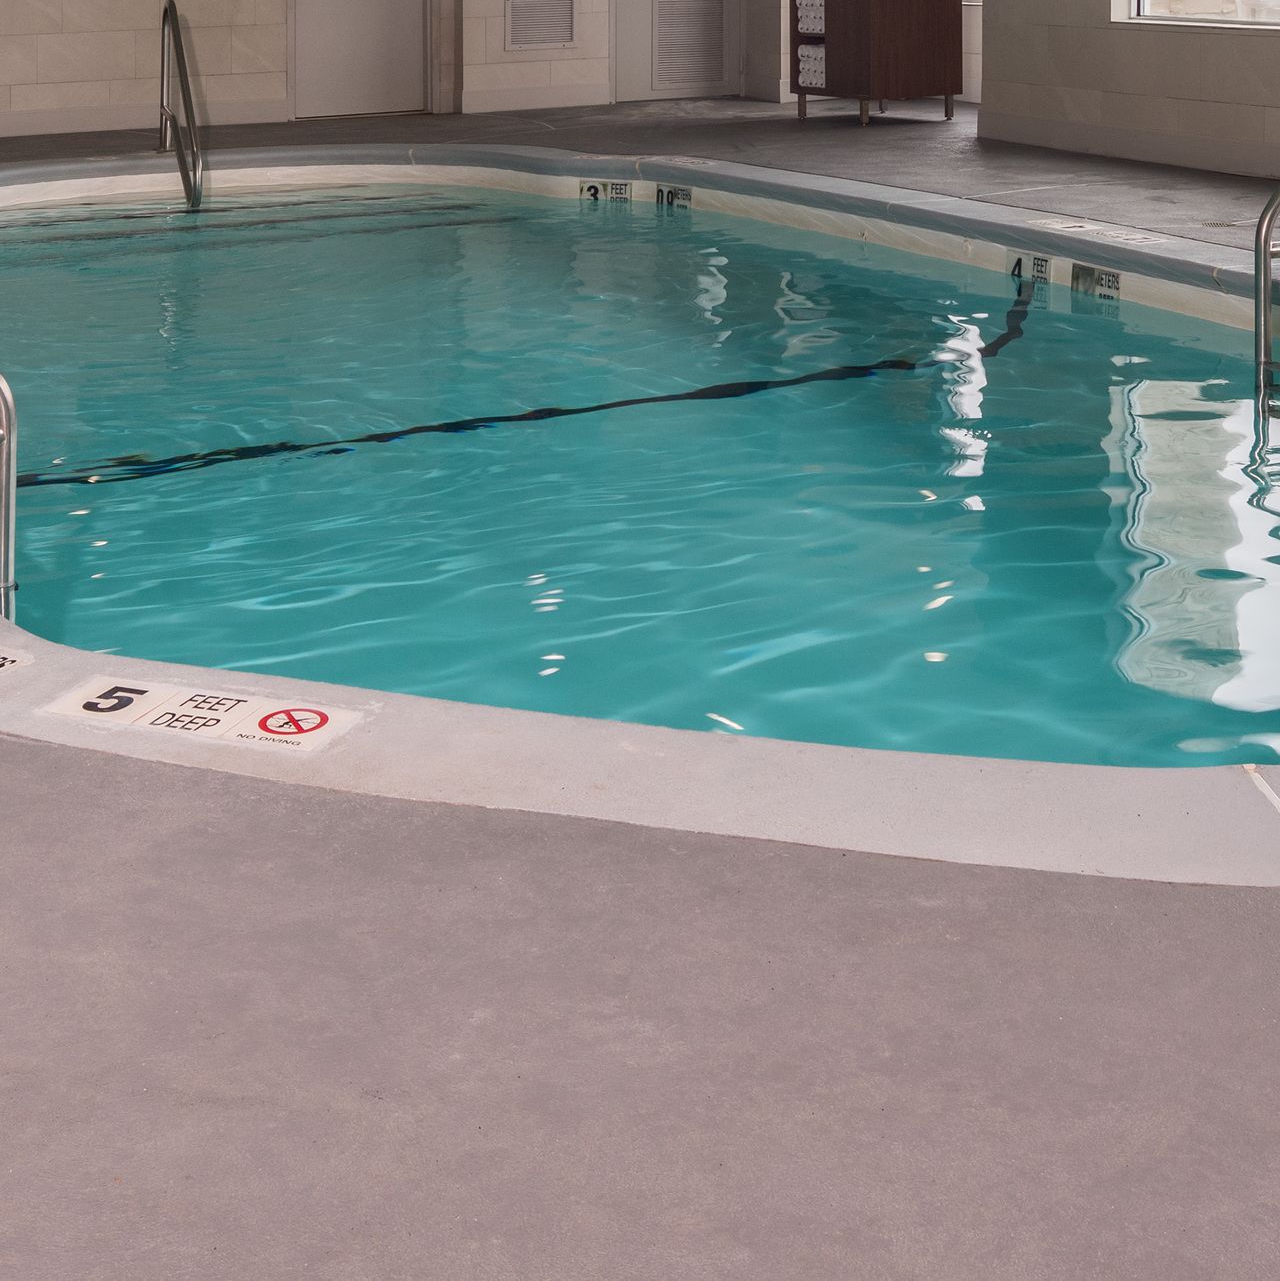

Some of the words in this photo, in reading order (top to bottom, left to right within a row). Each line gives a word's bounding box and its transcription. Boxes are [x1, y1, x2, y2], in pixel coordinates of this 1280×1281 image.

[586, 185, 599, 200] 3
[610, 183, 629, 196] FEET
[674, 186, 692, 201] METERS
[1011, 257, 1023, 278] 4
[1032, 257, 1048, 274] FEET
[1095, 271, 1120, 291] METERS
[82, 685, 149, 713] 5
[179, 693, 248, 713] FEET
[148, 711, 221, 732] DEEP
[236, 732, 257, 740] NO
[258, 736, 303, 747] DIVING
